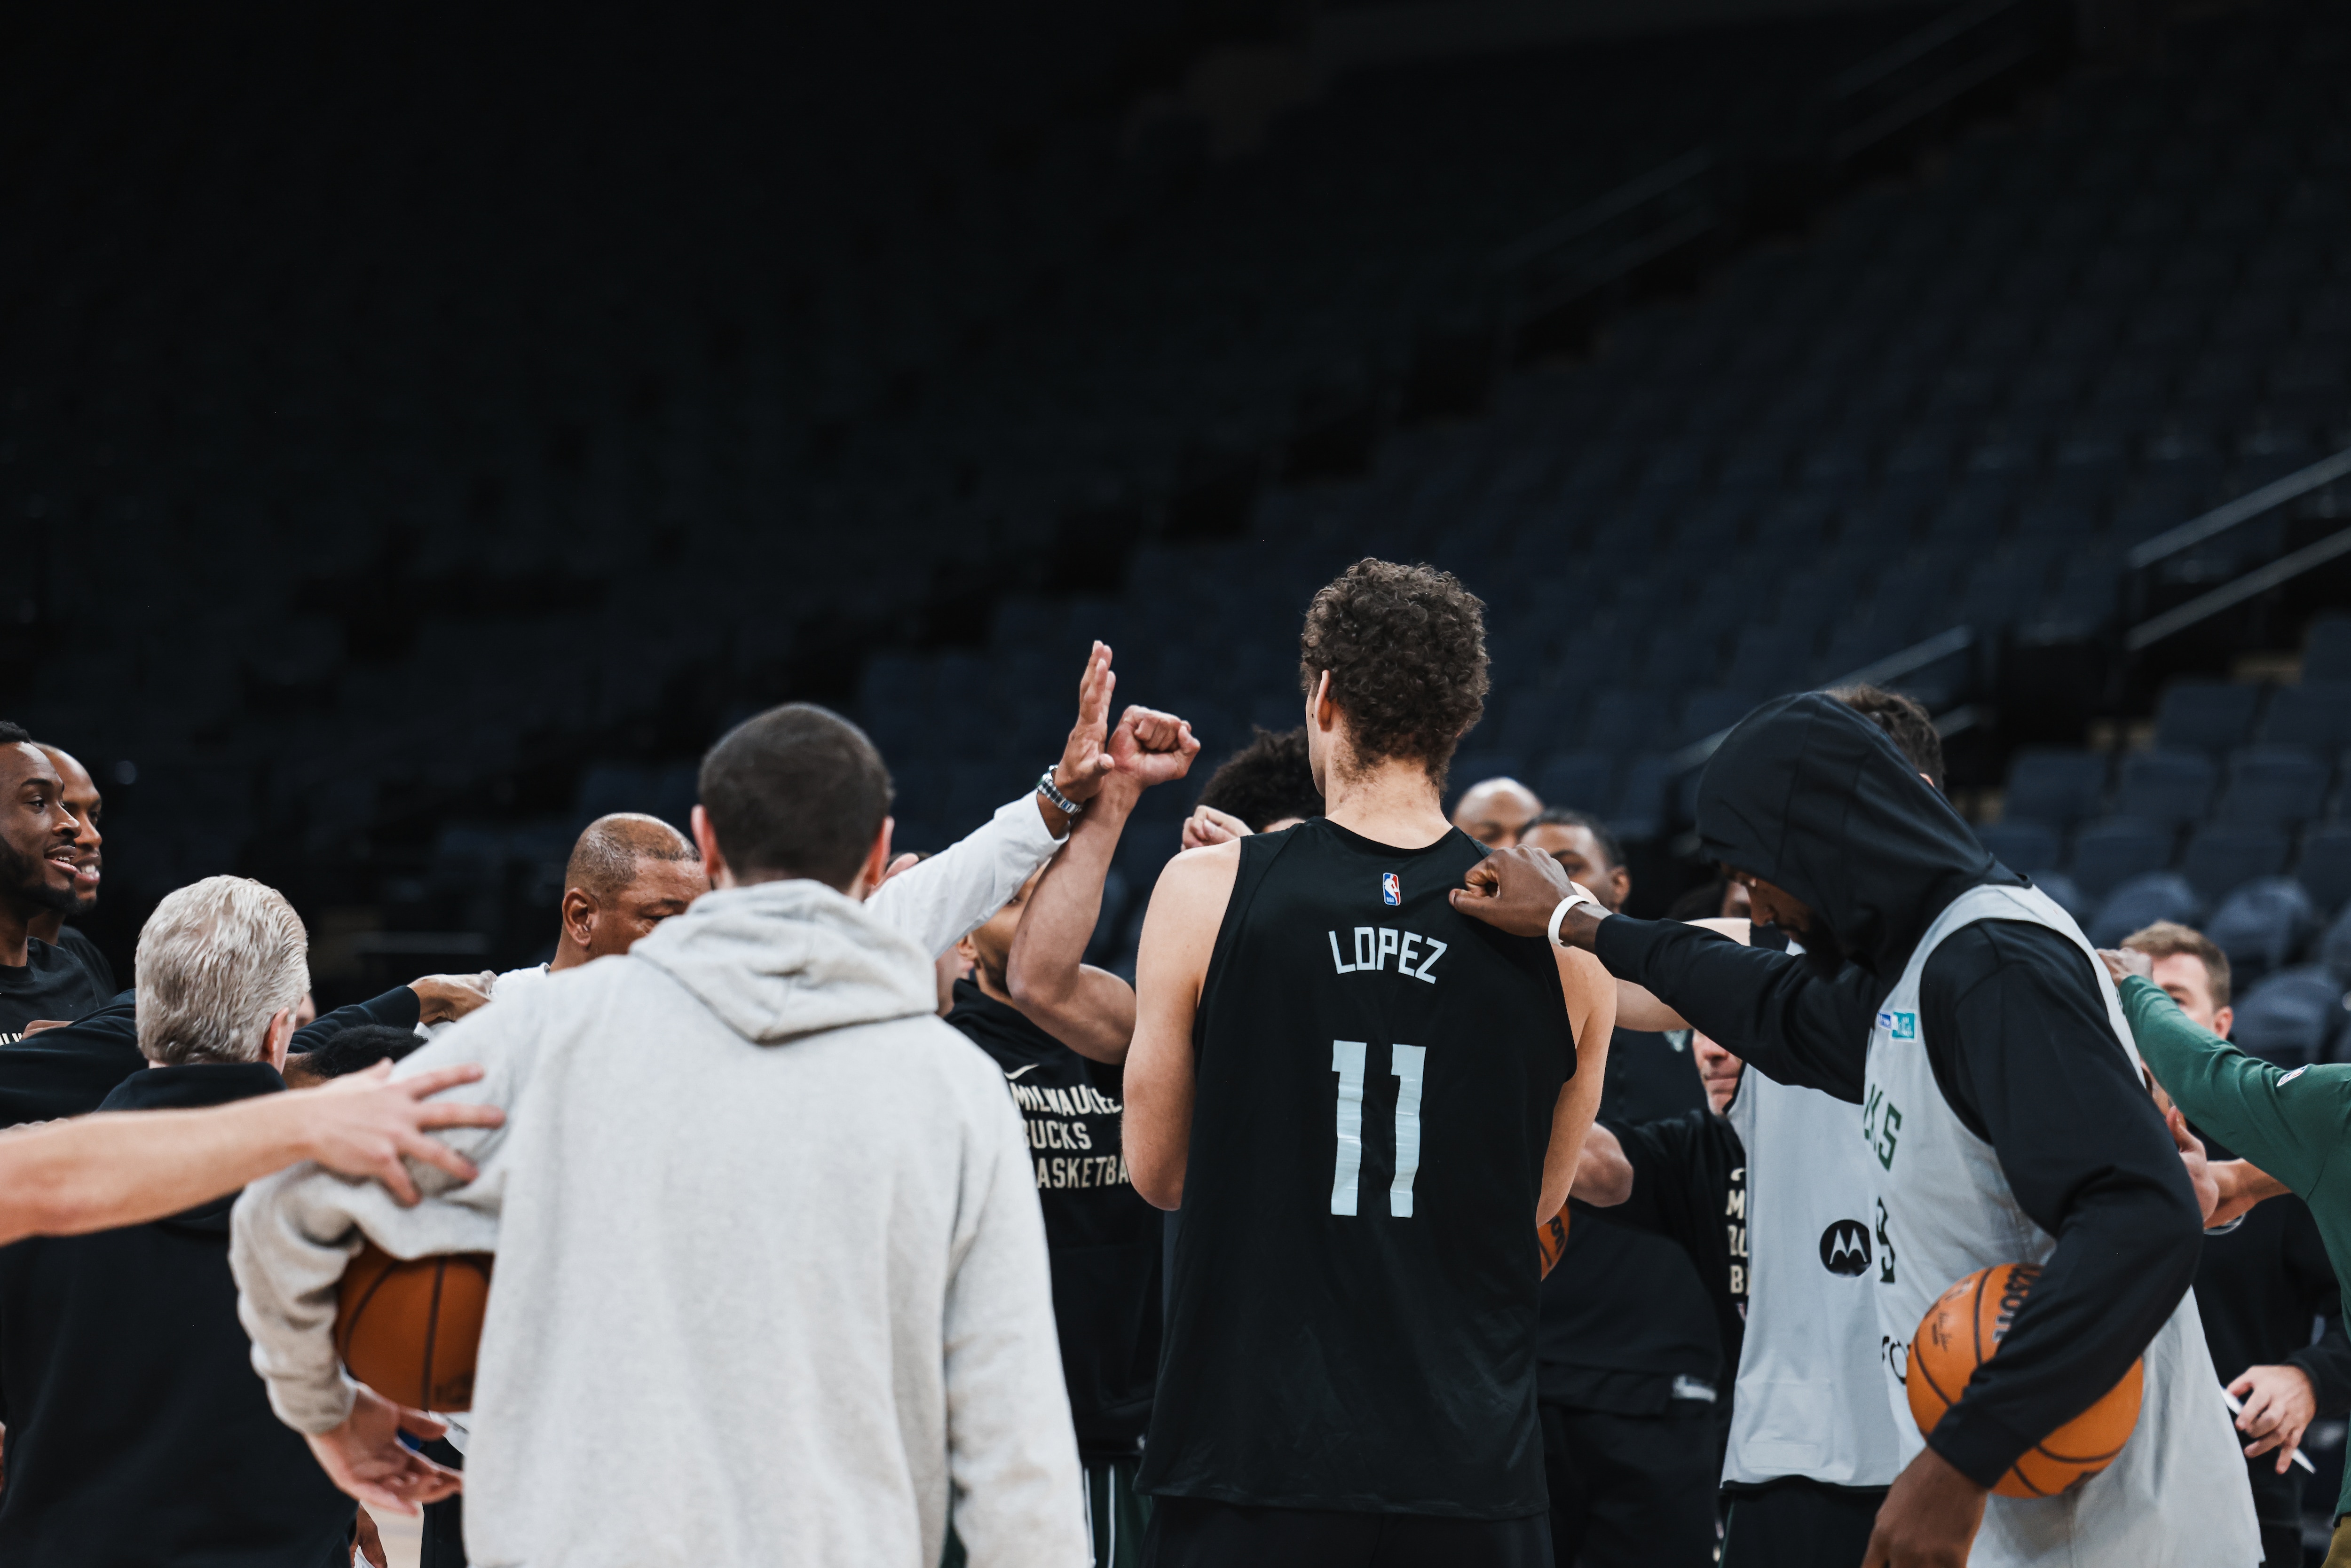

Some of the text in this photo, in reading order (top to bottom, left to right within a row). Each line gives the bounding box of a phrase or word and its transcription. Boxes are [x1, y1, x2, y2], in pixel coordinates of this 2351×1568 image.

[1328, 926, 1448, 984] LOPEZ
[1331, 1040, 1427, 1218] 11
[1037, 1155, 1130, 1189] ASKETBA
